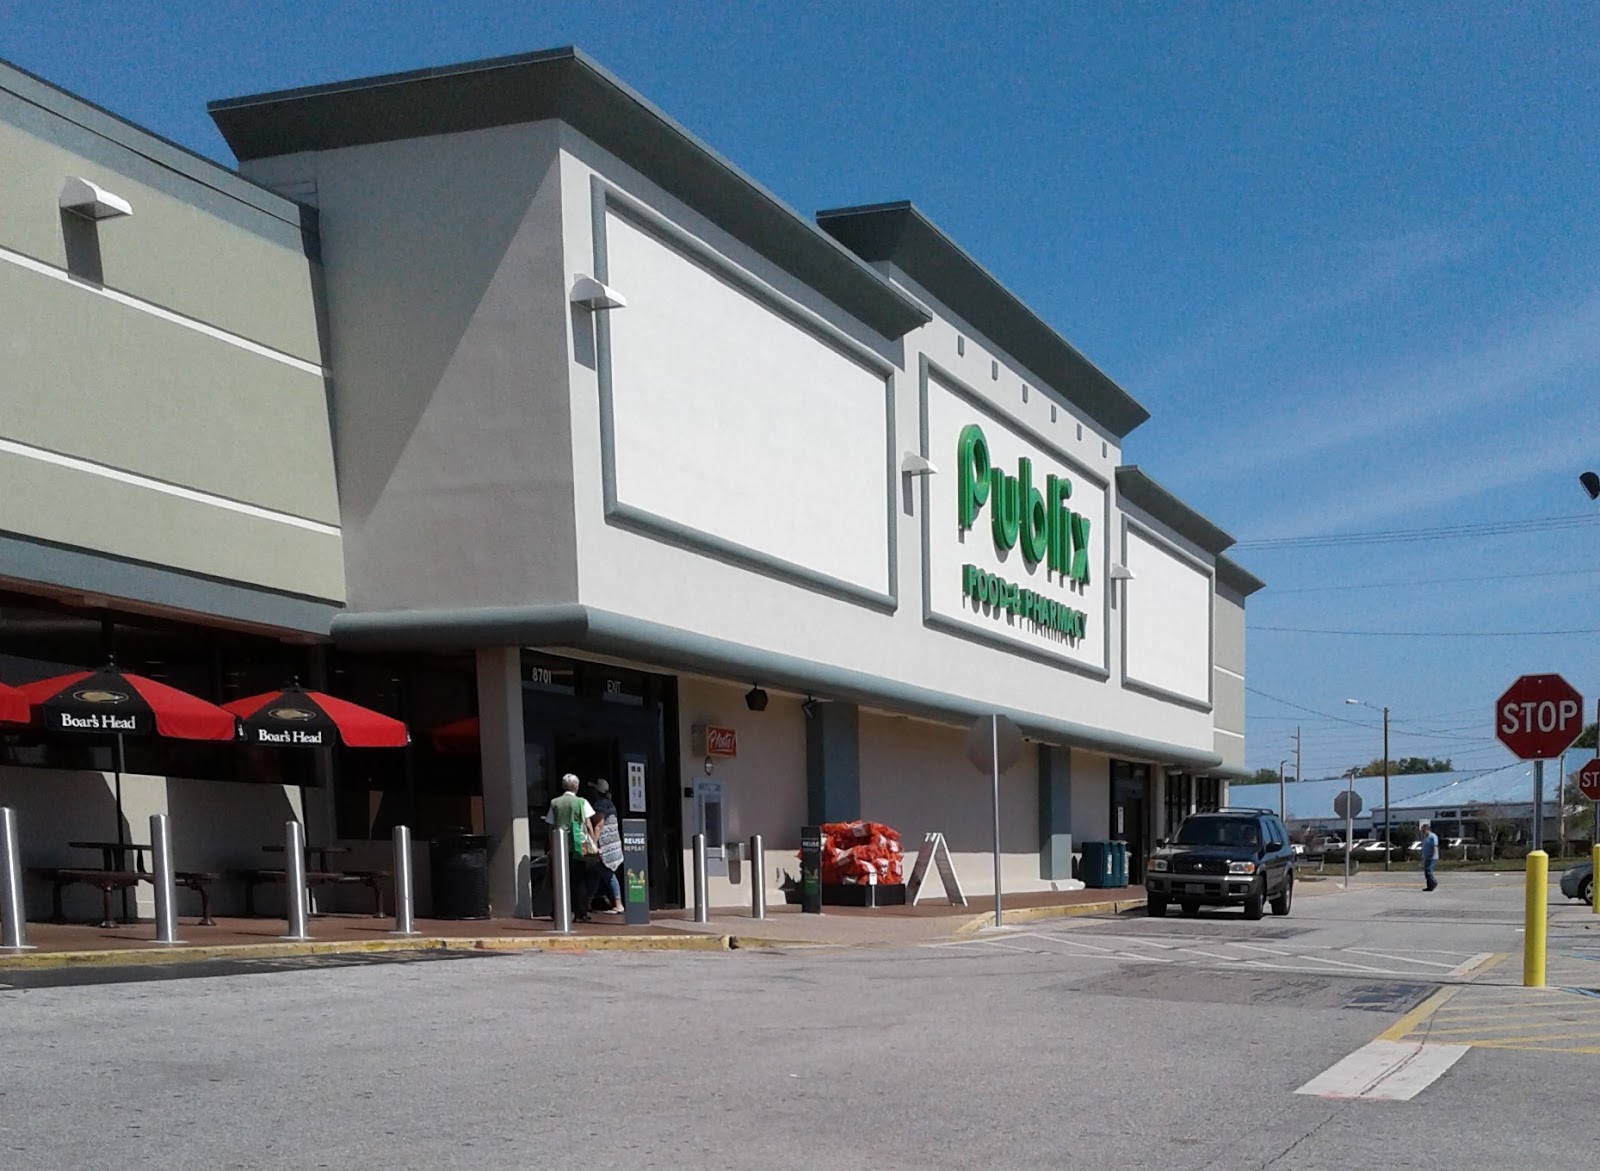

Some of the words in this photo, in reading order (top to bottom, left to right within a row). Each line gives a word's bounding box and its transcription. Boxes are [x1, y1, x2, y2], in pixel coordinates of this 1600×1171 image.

[958, 424, 1091, 586] Publix
[962, 564, 1008, 608] FOOD
[1020, 589, 1088, 640] PHARMACY
[532, 667, 552, 684] 8701
[607, 680, 621, 693] EXIT
[61, 713, 100, 728] Boar's
[101, 715, 136, 729] Head
[1502, 700, 1578, 734] STOP
[258, 729, 291, 743] Boar's
[292, 731, 322, 743] Head
